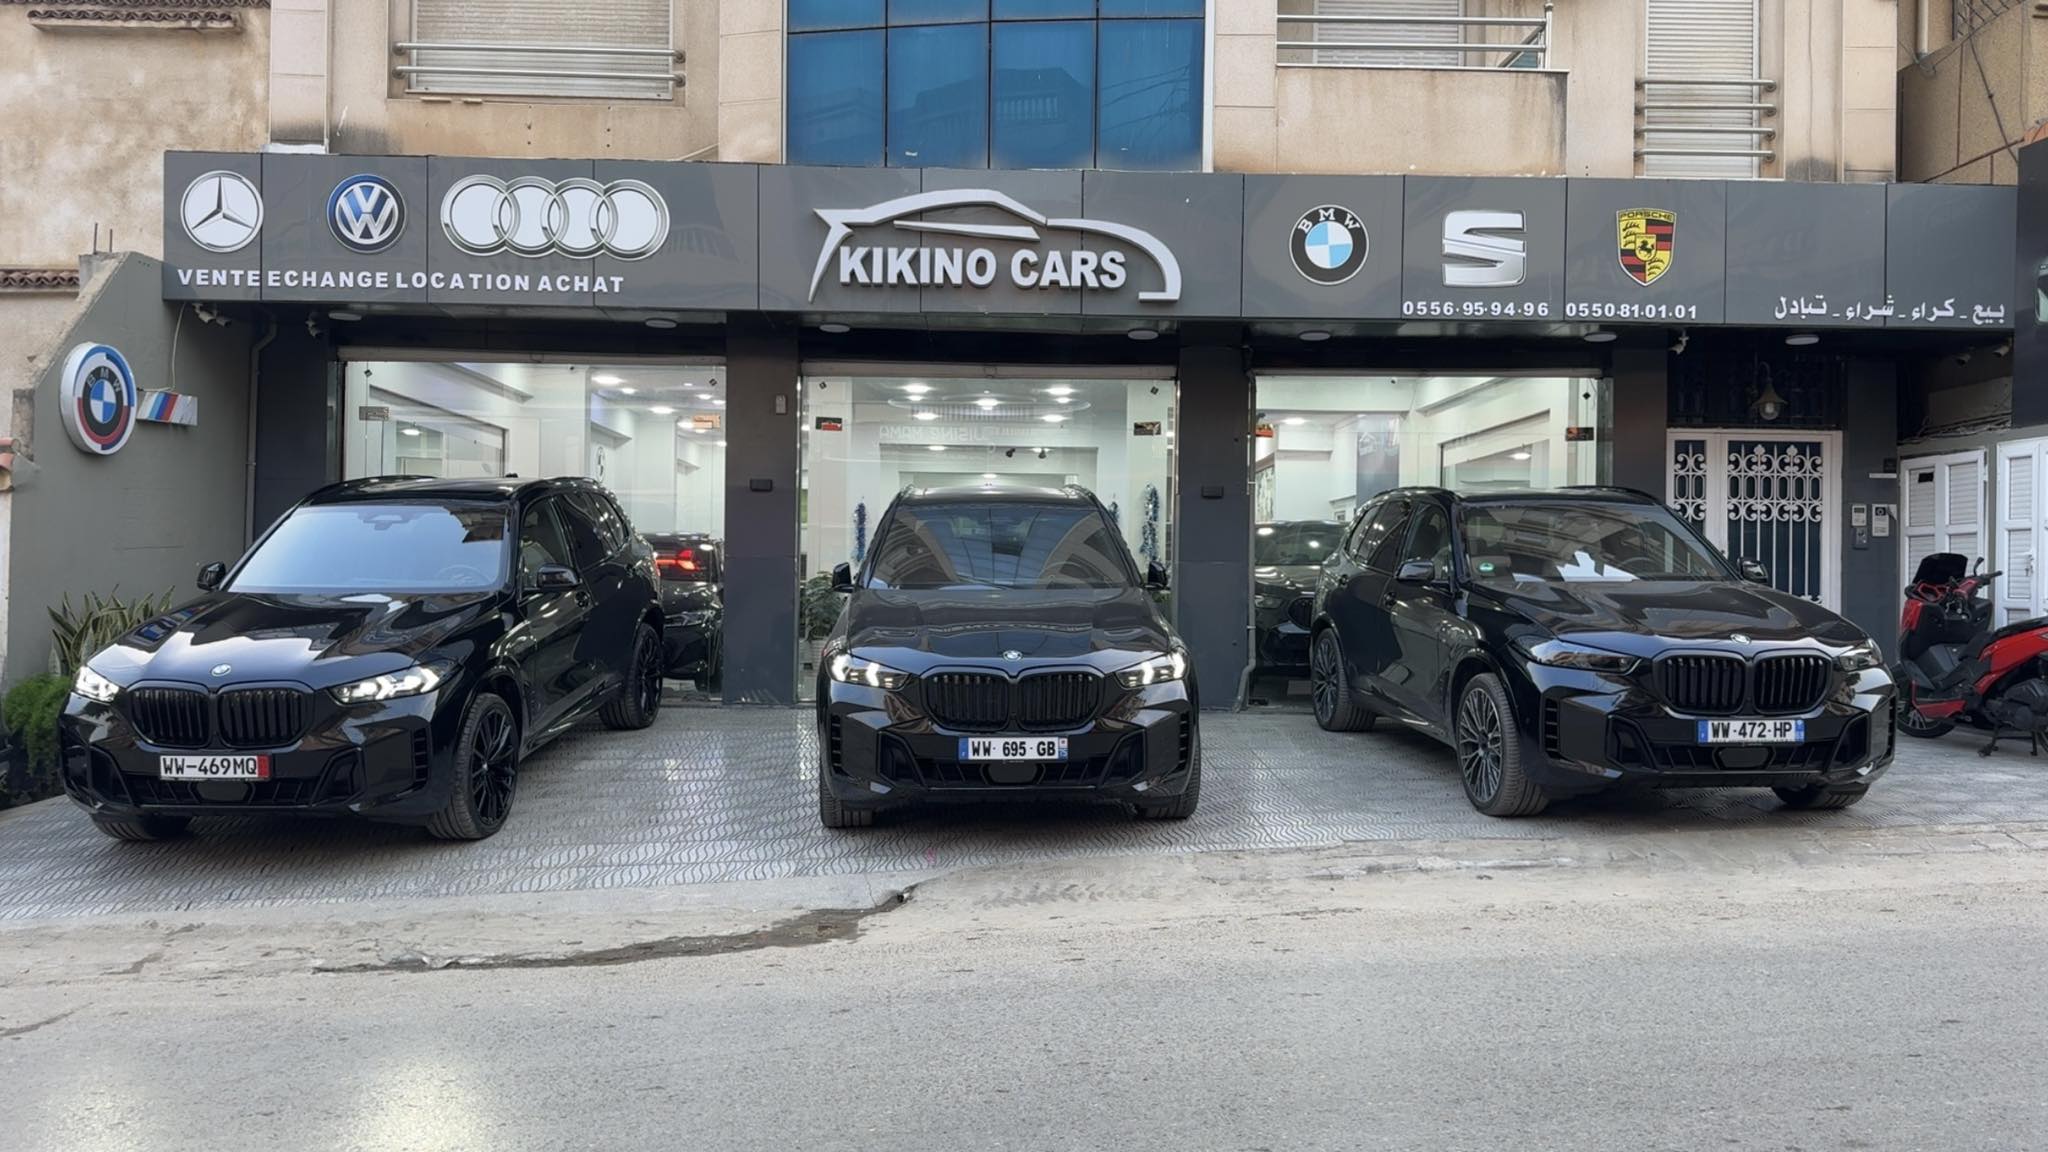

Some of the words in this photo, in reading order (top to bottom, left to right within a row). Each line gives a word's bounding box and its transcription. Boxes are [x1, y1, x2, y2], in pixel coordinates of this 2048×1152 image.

[1297, 207, 1361, 234] BMW
[1619, 210, 1673, 221] PORSCHE
[177, 269, 261, 287] VENTE
[267, 270, 389, 289] ECHANGE
[395, 271, 531, 291] LOCATION
[537, 275, 625, 293] ACHAT
[840, 246, 997, 289] KIKINO
[1011, 248, 1127, 291] CARS
[1775, 294, 1827, 319] تبادل
[1846, 294, 1895, 321] شراء
[1911, 298, 1955, 321] كراء
[1972, 303, 2005, 325] بيع
[86, 367, 122, 393] BMW
